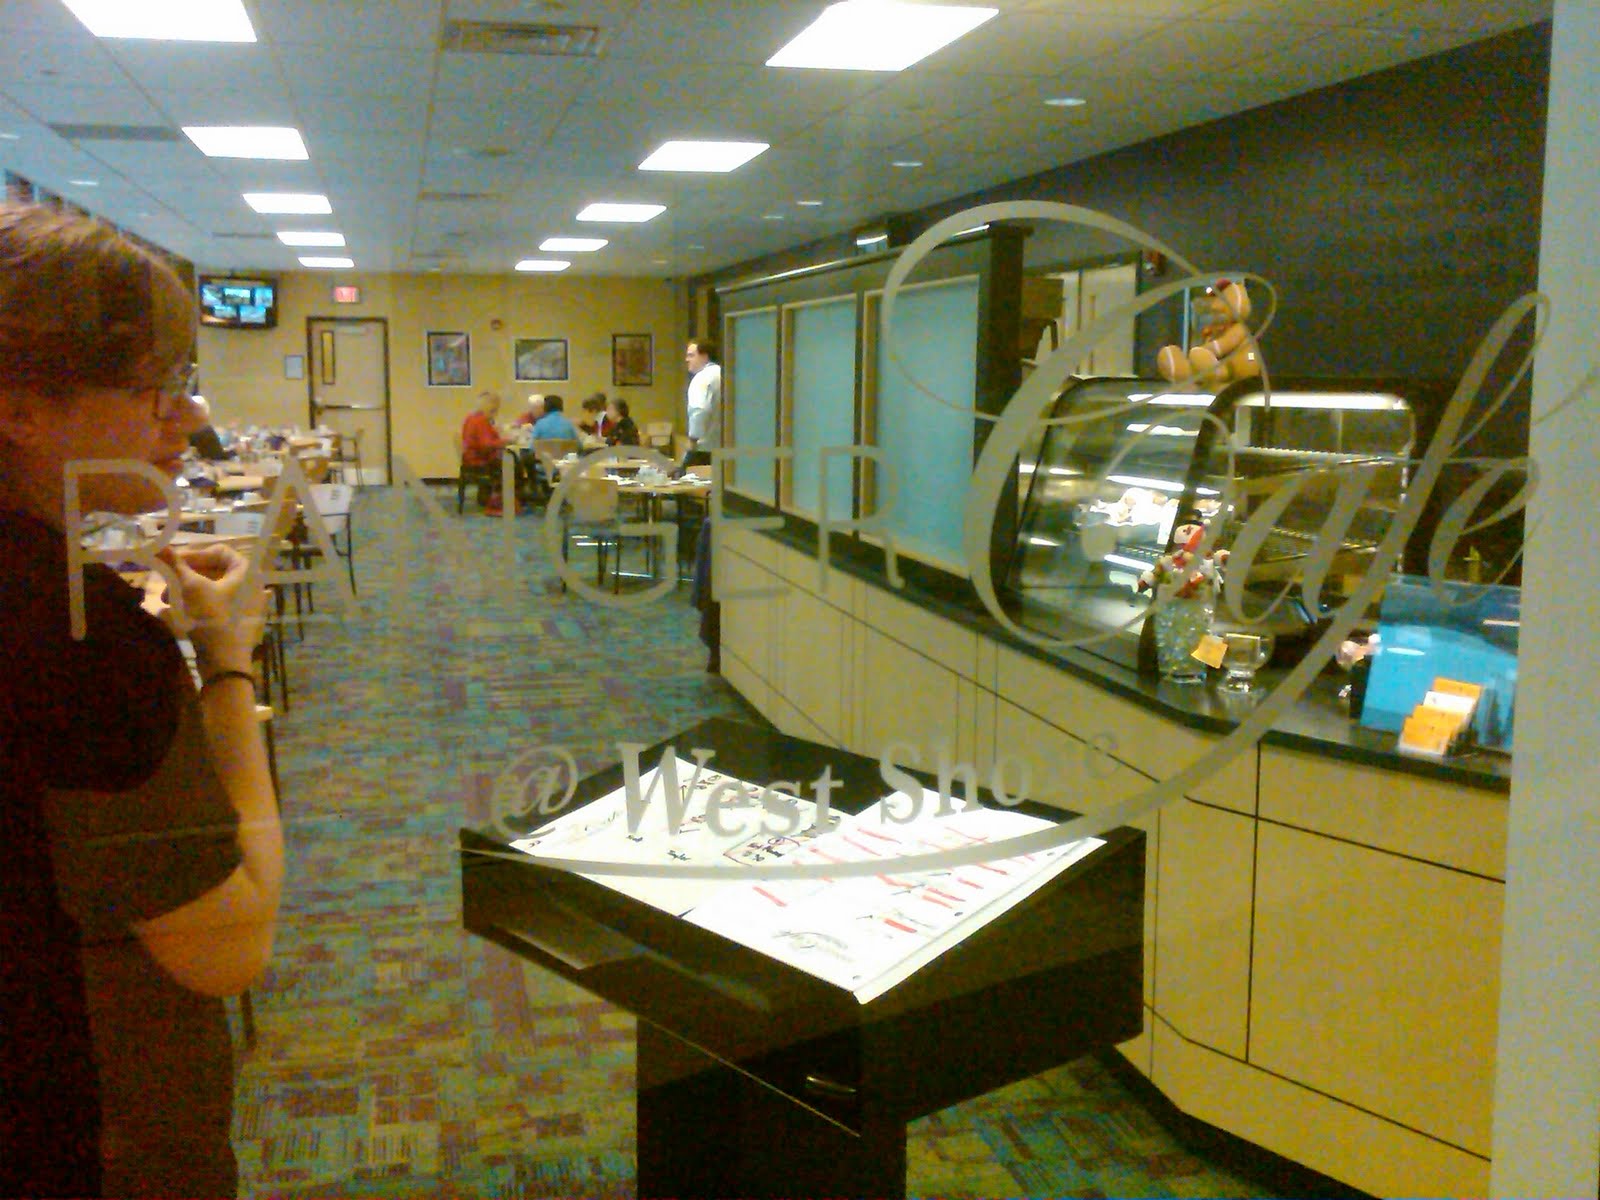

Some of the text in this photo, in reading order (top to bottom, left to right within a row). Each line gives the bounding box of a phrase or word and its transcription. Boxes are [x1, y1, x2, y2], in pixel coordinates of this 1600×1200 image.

[491, 745, 579, 841] @
[616, 742, 845, 839] West
[879, 731, 1119, 828] Shoe
